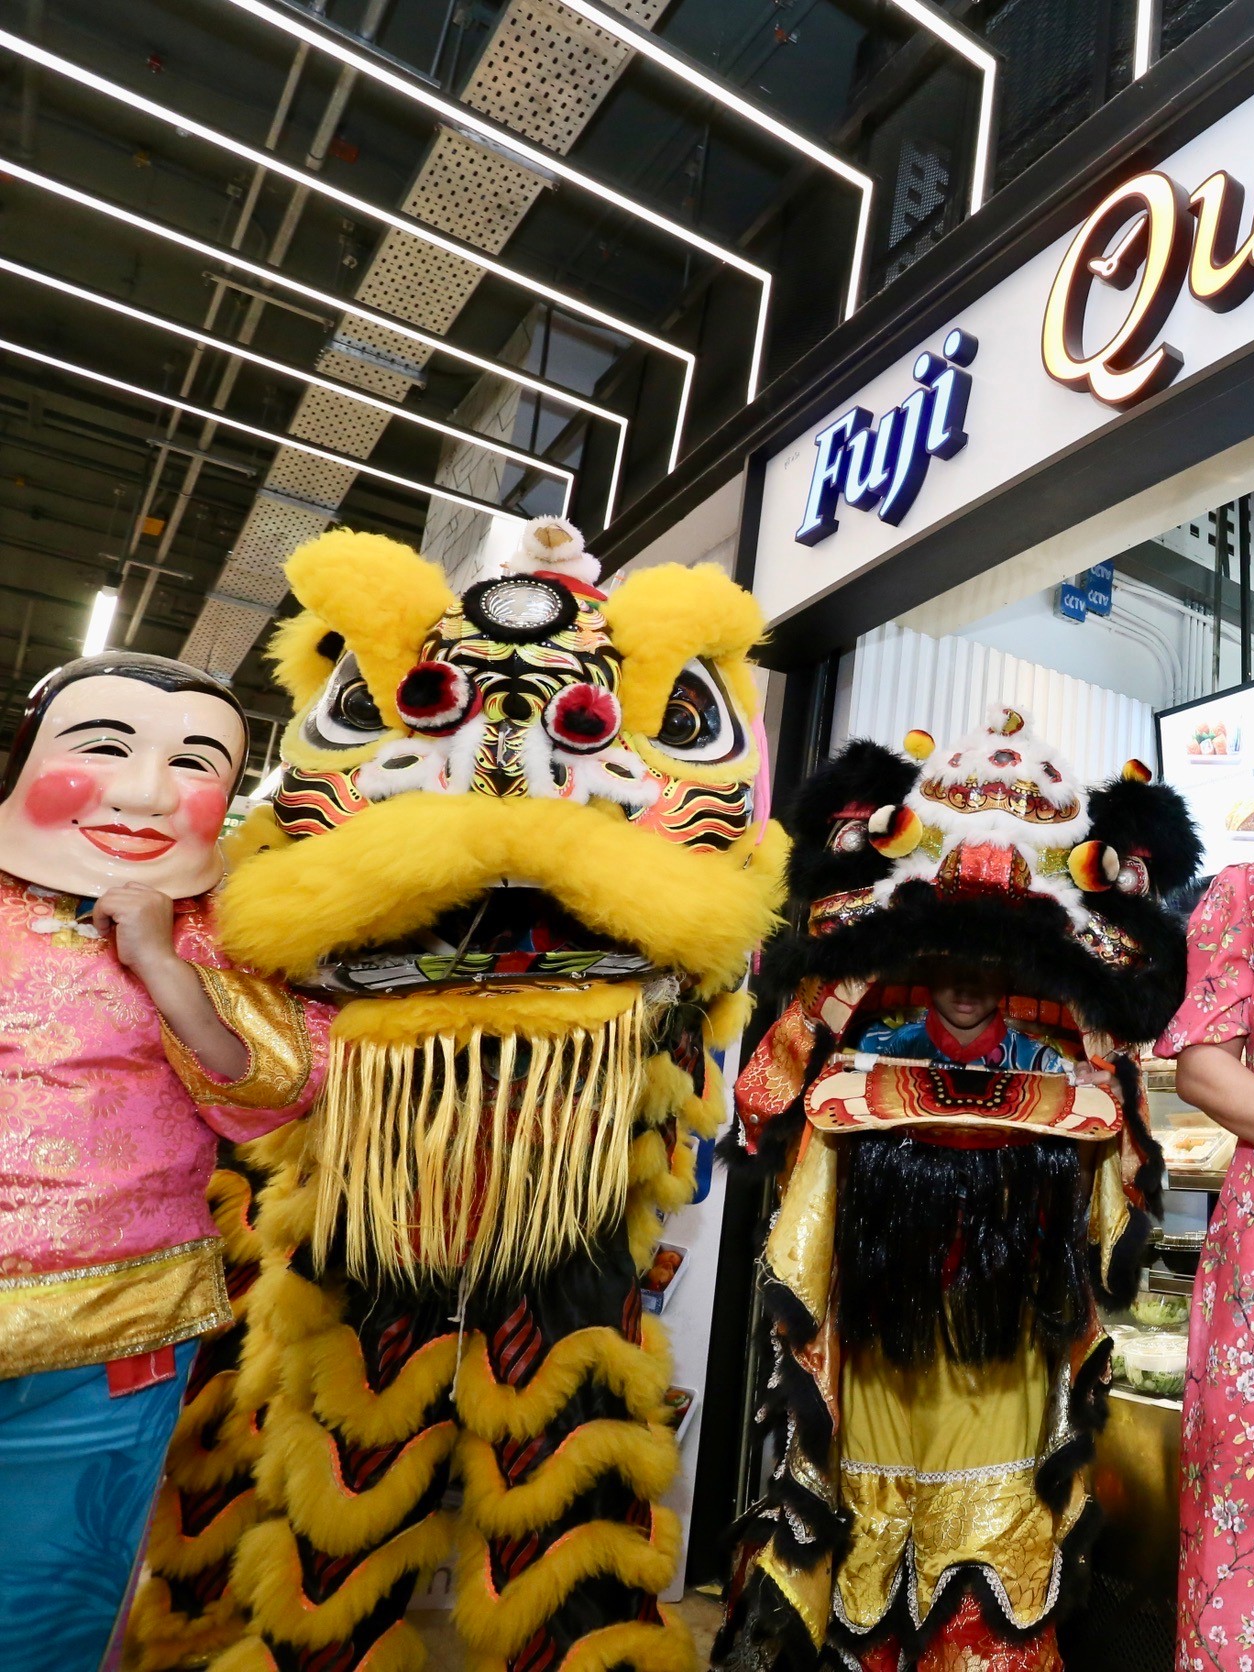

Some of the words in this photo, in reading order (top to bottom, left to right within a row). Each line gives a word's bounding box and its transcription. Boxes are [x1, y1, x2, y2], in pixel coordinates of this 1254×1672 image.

[795, 327, 979, 548] Fuji
[1064, 593, 1086, 612] CCTV
[1087, 589, 1109, 607] CCTV
